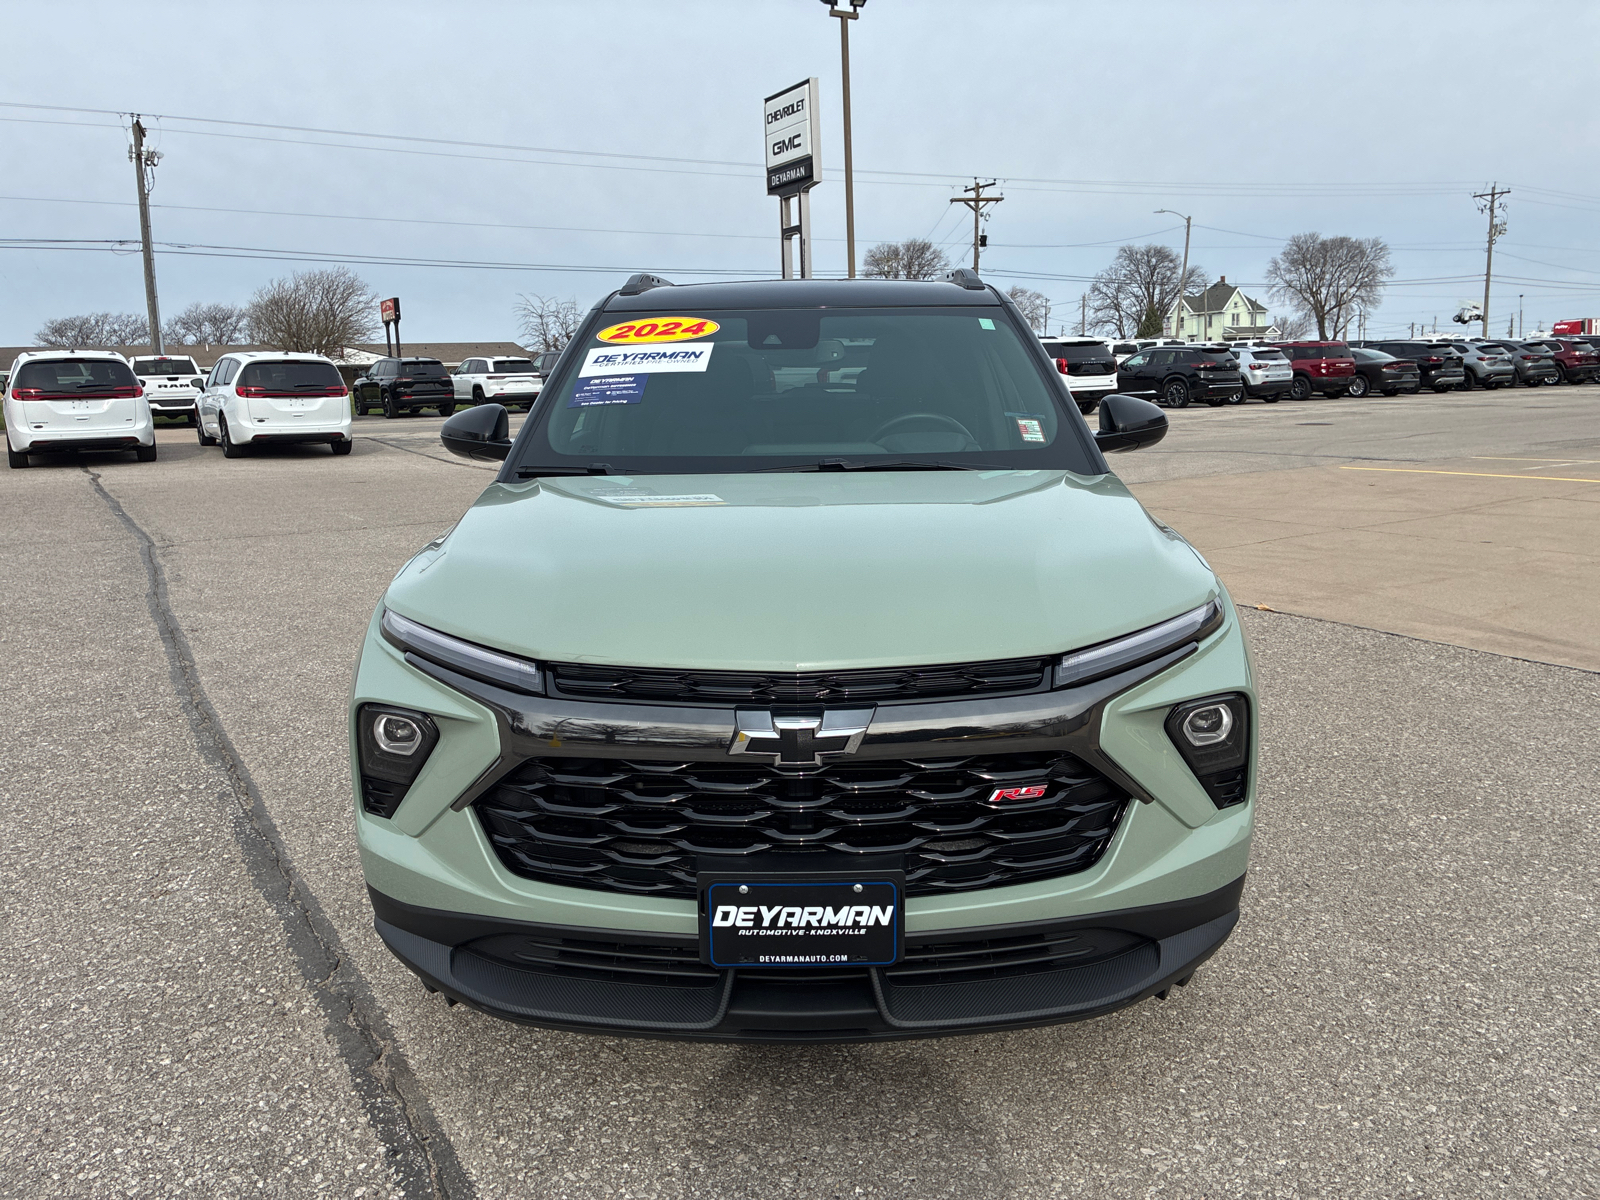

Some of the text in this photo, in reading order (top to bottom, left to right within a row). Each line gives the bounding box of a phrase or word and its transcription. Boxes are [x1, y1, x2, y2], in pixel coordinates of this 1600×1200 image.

[767, 98, 805, 125] CHEVROLET
[772, 133, 802, 156] GMC
[771, 165, 805, 186] DEYARMAN
[607, 321, 709, 341] 2024
[592, 351, 705, 364] DEYARMAN
[988, 784, 1048, 802] RS
[712, 905, 894, 928] DEYARMAN
[738, 928, 867, 936] AUTOMOTIVE-KNOXVILLE
[759, 954, 848, 963] DEYARMANAUTO.COM
